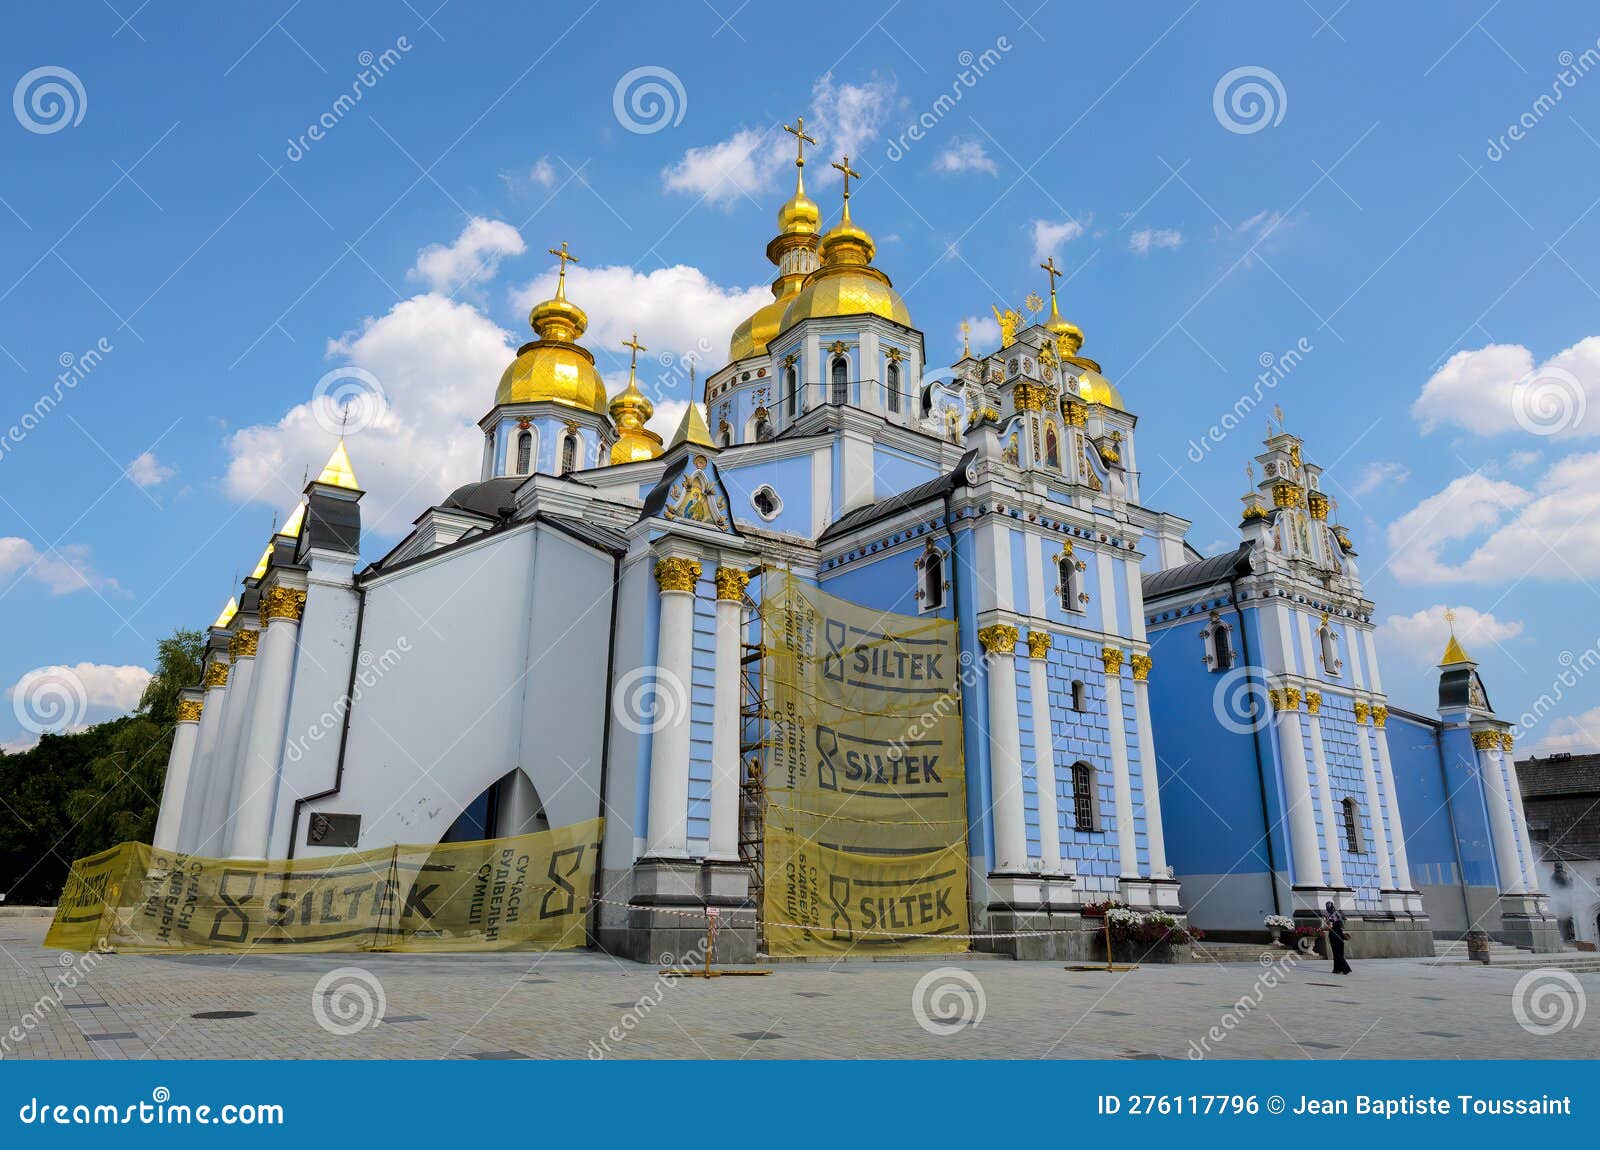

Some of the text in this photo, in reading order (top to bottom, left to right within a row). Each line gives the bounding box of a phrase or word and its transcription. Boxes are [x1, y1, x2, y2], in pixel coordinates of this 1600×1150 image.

[853, 643, 944, 681] SILTEK
[845, 750, 943, 785] SILTEK
[266, 880, 440, 927] SILTEK
[469, 863, 493, 925] СУМІШІ
[486, 848, 515, 942] БУДІВЕЛЬНІ
[505, 855, 530, 923] СУЧАСНІ
[860, 886, 954, 930] SILTEK
